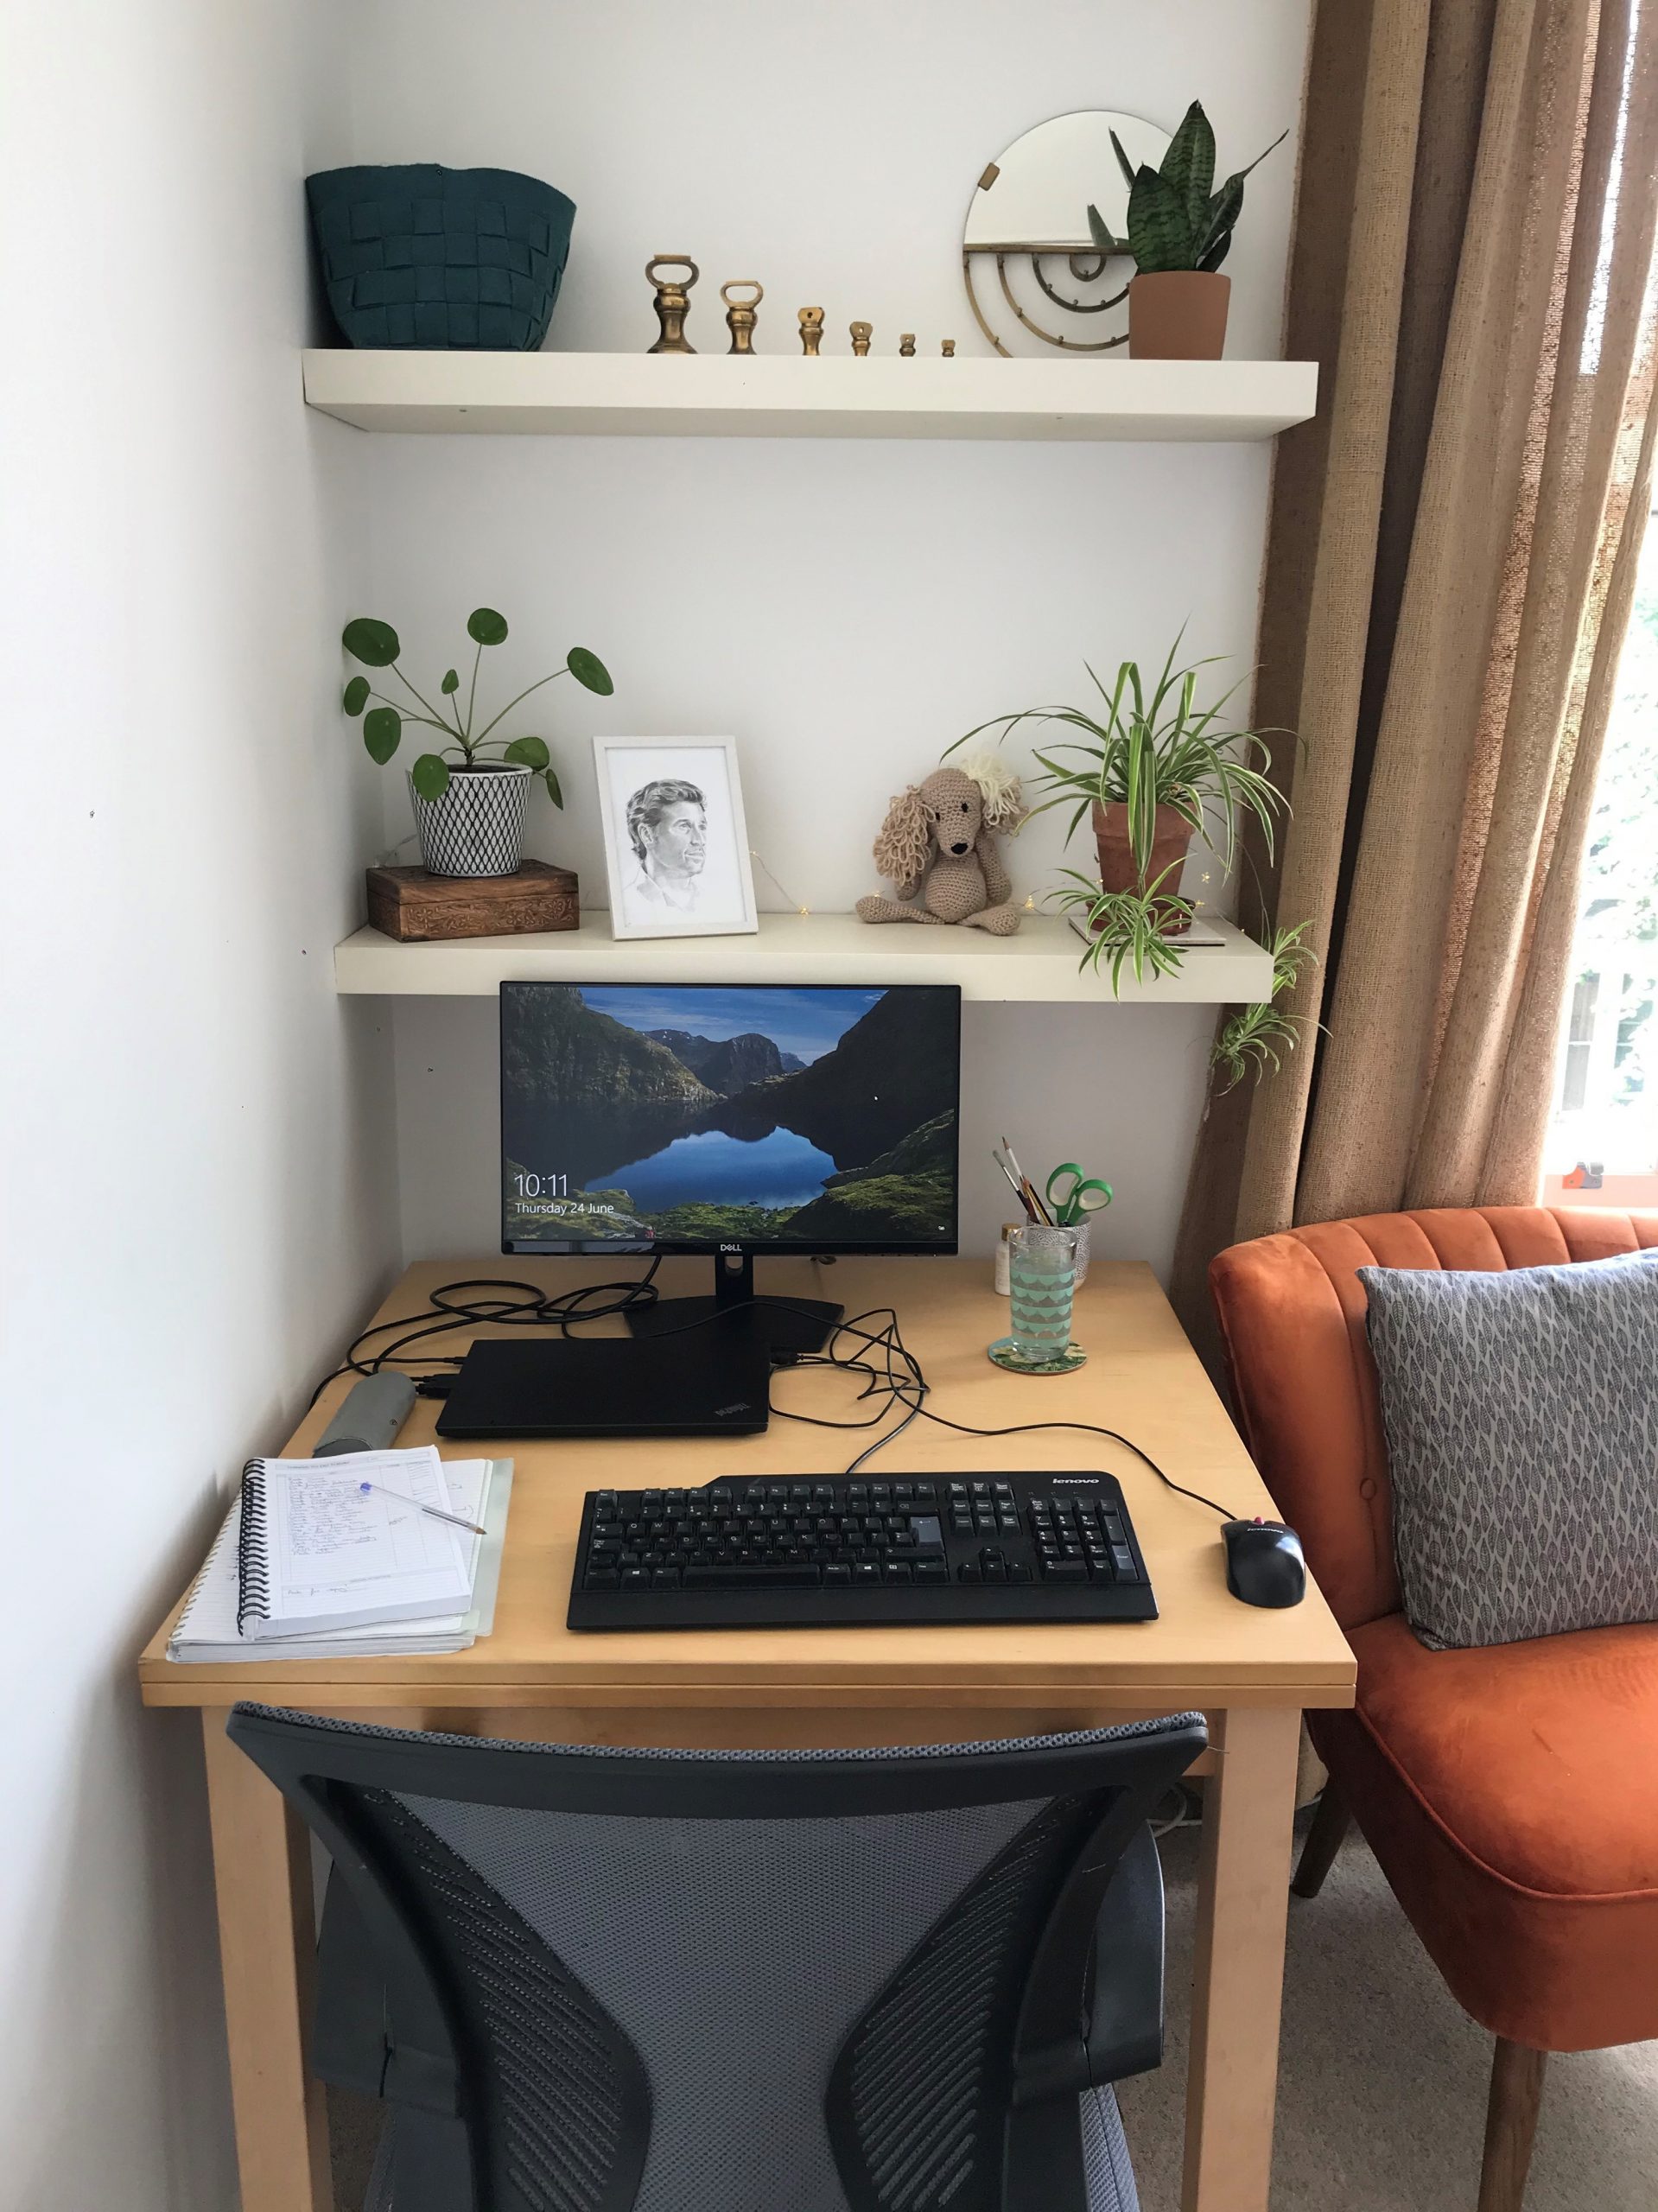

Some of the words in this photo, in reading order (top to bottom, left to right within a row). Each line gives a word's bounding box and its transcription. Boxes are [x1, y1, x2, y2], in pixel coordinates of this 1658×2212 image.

[514, 1173, 568, 1197] 10:11
[515, 1203, 568, 1216] Thursday
[570, 1203, 585, 1213] 24
[588, 1203, 614, 1214] June
[720, 1243, 742, 1252] DELL
